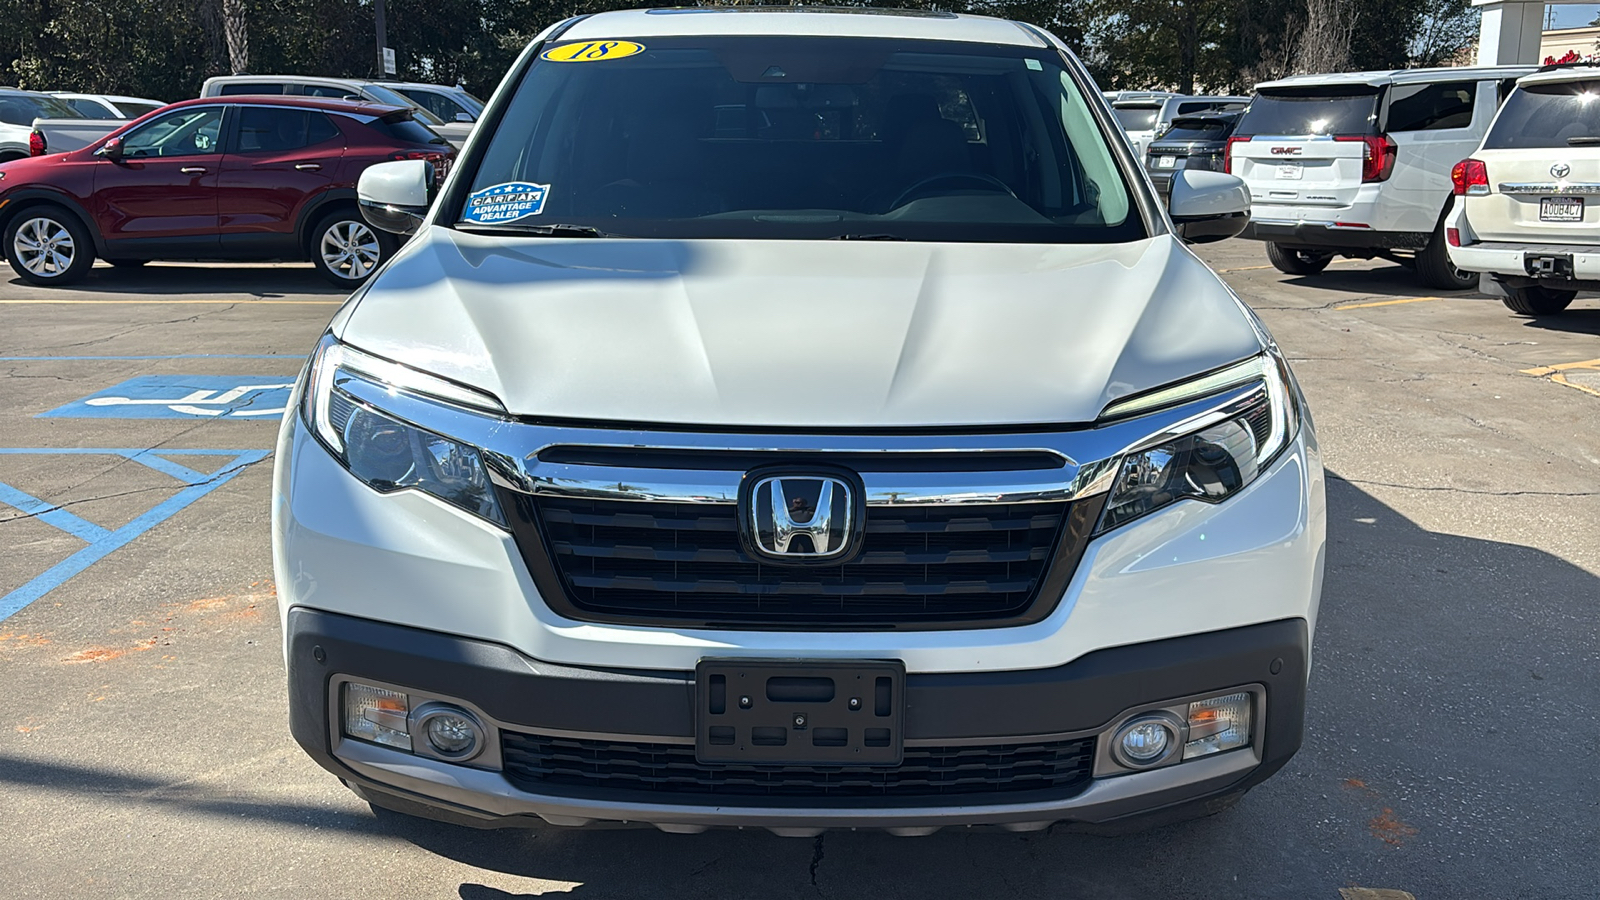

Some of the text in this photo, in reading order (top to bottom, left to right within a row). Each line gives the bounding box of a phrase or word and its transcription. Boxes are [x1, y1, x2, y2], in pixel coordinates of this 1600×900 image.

[564, 42, 618, 61] 18
[1271, 147, 1302, 155] GMC
[471, 192, 540, 206] CARFAX
[472, 202, 532, 215] ADVANTAGE
[480, 211, 519, 221] DEALER
